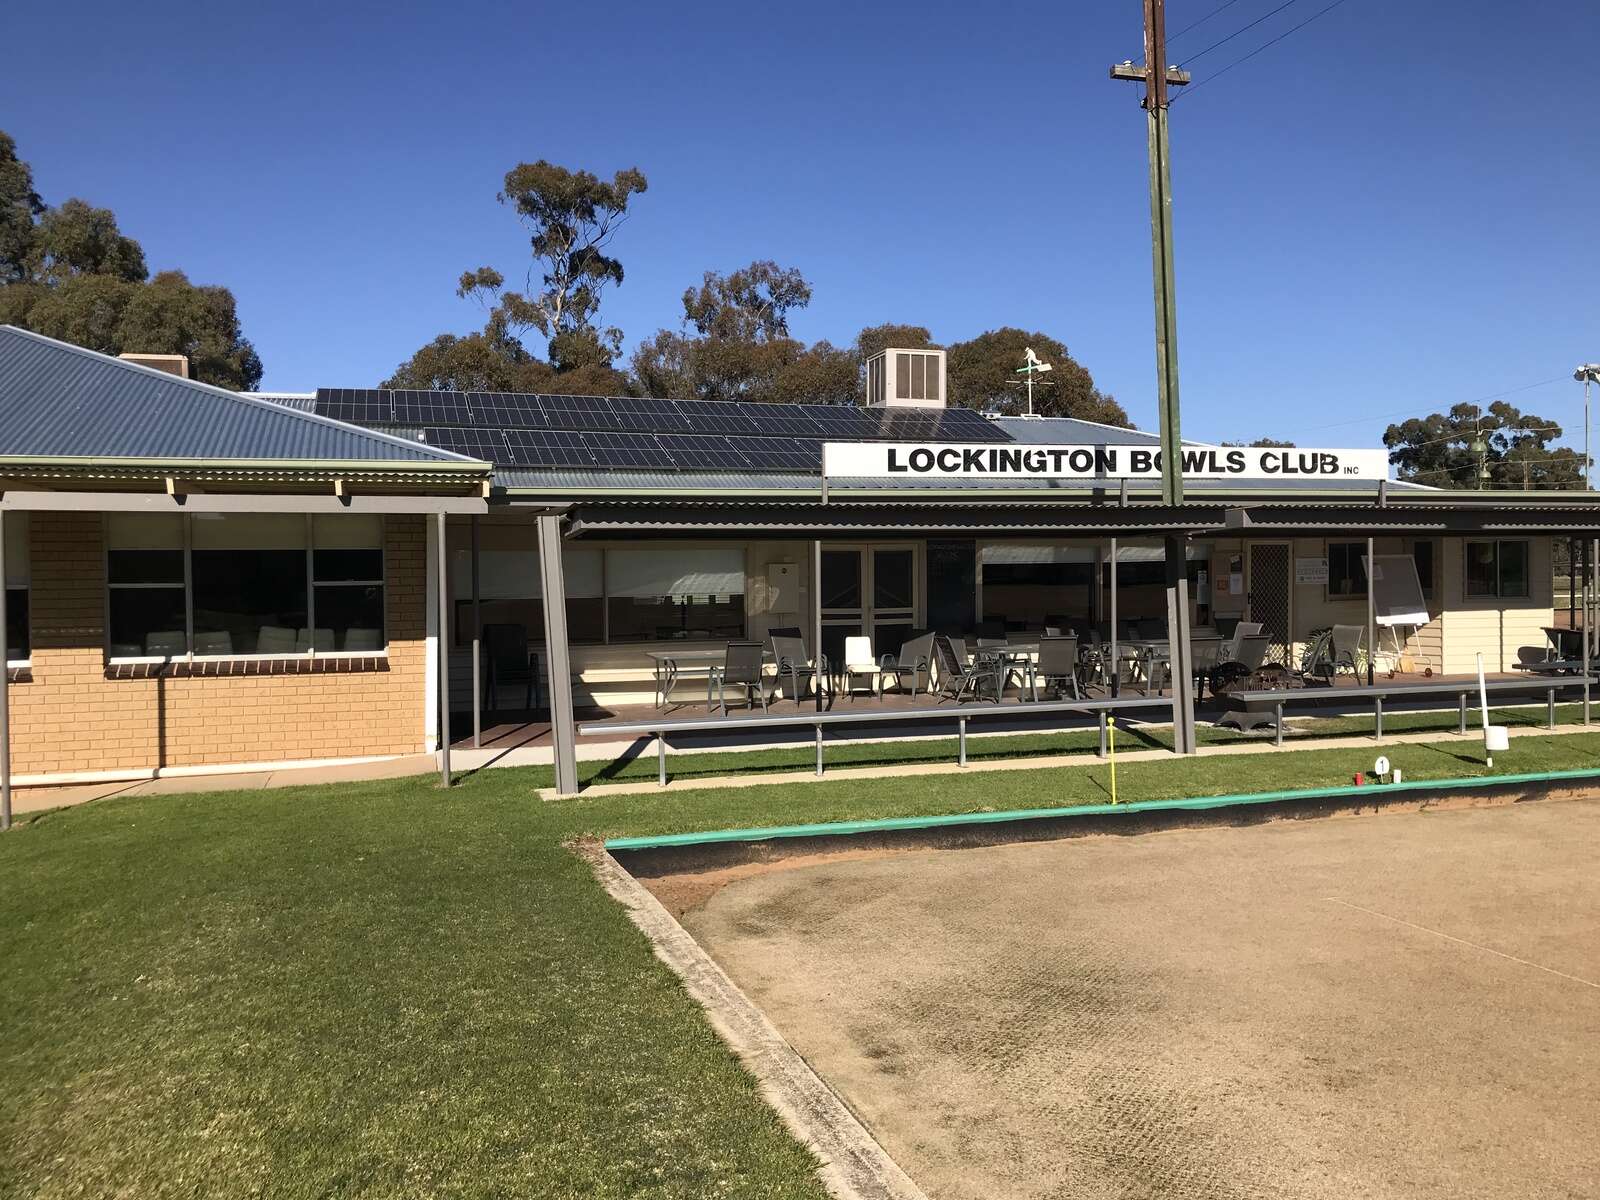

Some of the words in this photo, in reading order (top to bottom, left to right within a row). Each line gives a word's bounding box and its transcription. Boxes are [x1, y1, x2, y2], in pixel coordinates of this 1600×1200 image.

[887, 448, 1117, 473] LOCKINGTON
[1259, 452, 1340, 474] CLUB
[1343, 466, 1359, 475] INC
